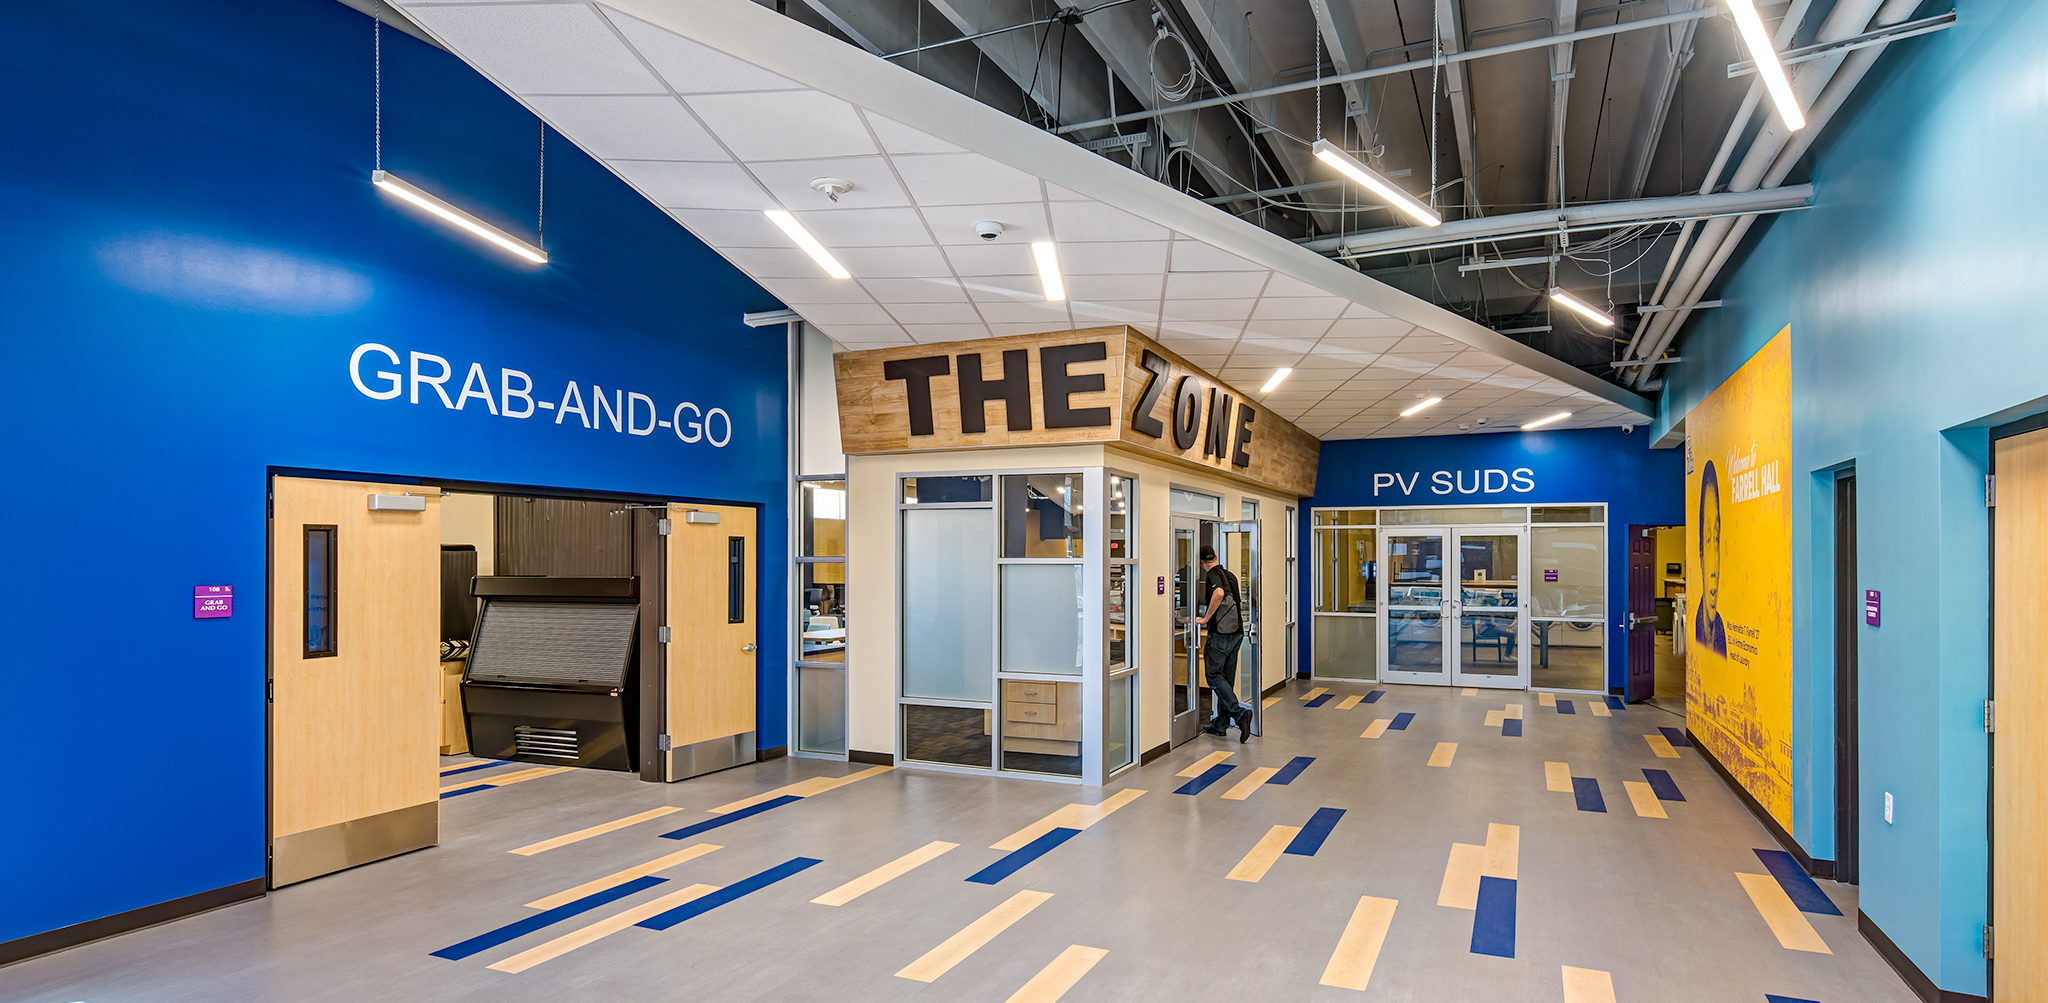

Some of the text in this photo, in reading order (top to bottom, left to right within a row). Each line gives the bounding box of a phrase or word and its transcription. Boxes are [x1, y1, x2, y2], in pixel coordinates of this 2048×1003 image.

[349, 343, 732, 448] GRAB-AND-GO
[883, 341, 1256, 468] THE ZONE
[1373, 467, 1535, 496] PV SUDS
[1725, 444, 1750, 482] Welcome
[1750, 440, 1758, 468] to
[1732, 460, 1781, 504] FARRELL HALL
